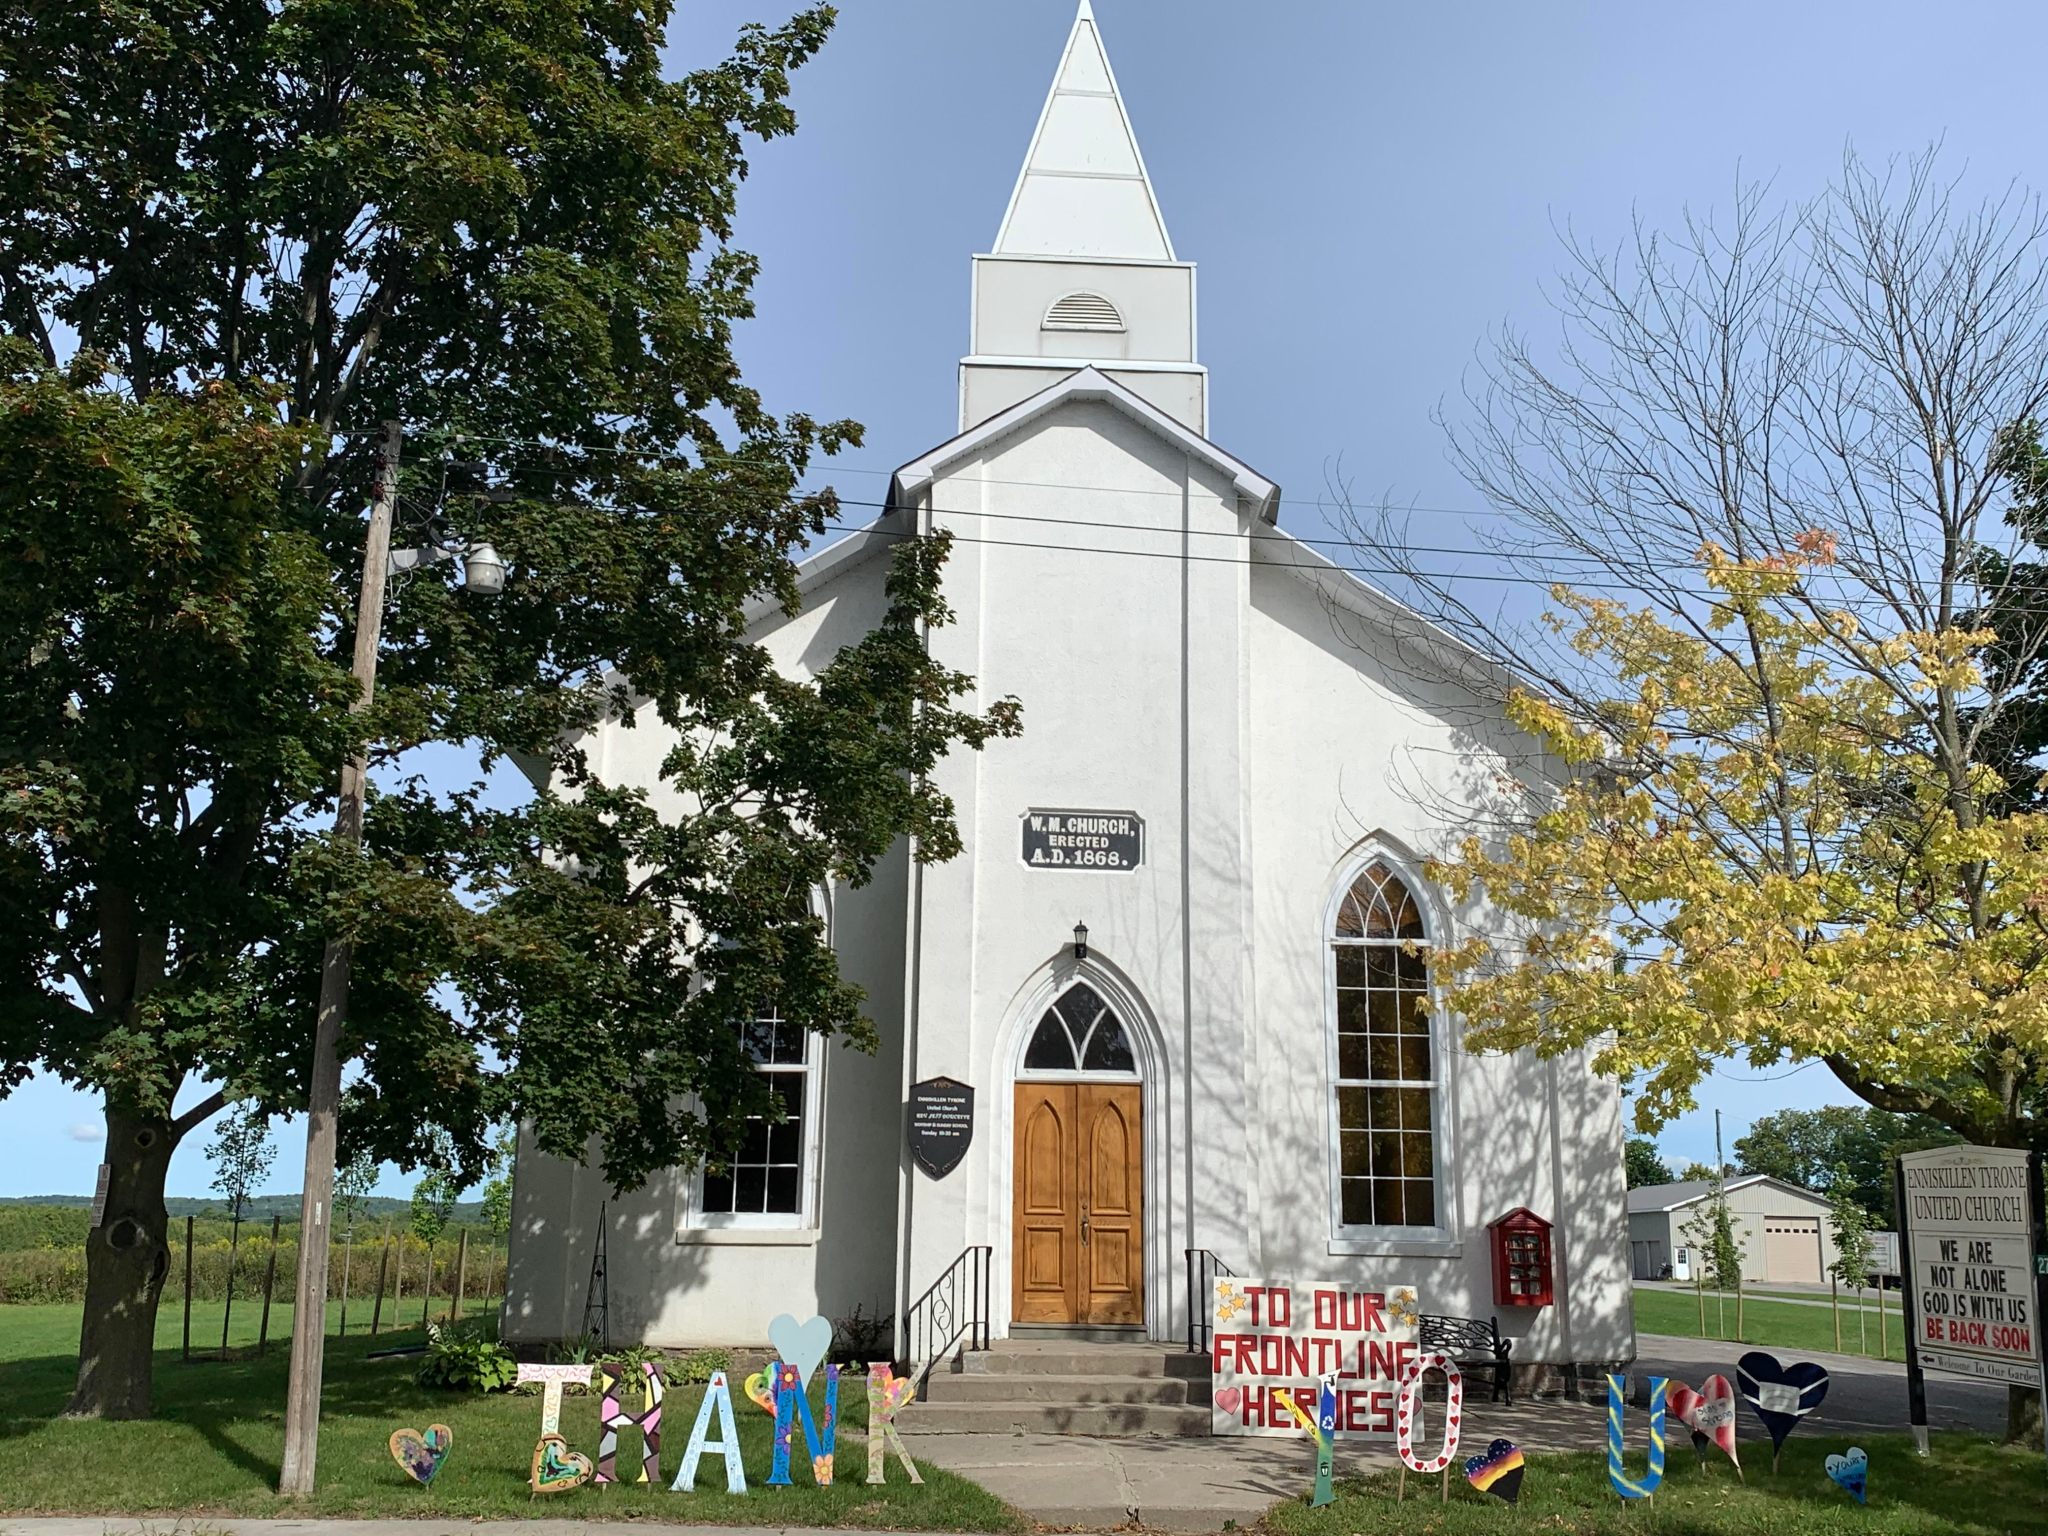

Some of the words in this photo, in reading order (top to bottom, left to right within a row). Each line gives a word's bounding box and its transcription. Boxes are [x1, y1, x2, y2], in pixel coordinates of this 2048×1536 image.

[1067, 817, 1136, 837] CHURCH,
[1048, 834, 1110, 848] ERECTED
[1030, 848, 1071, 865] A.D.
[1073, 849, 1129, 867] 1868.
[1906, 1167, 1977, 1189] ENNISKILLEN
[1978, 1166, 2027, 1189] TYRONE
[1913, 1195, 1962, 1221] UNITED
[1964, 1195, 2023, 1222] CHURCH
[1939, 1240, 1959, 1262] WE
[1968, 1241, 1993, 1264] ARE
[1930, 1265, 1955, 1289] NOT
[1964, 1267, 2007, 1293] ALONE
[1243, 1286, 1290, 1327] TO
[1314, 1290, 1386, 1333] OUR
[1923, 1291, 1950, 1314] GOD
[1953, 1293, 1967, 1317] IS
[1970, 1295, 2004, 1321] WITH
[2008, 1298, 2027, 1324] US
[1926, 1317, 1945, 1340] BE
[1949, 1320, 1988, 1346] BACK
[1992, 1325, 2031, 1352] SOON
[1937, 1355, 1970, 1371] Welcome
[1974, 1361, 1985, 1374] To
[1987, 1363, 2005, 1377] Our
[2008, 1367, 2040, 1383] Garden
[1242, 1385, 1394, 1432] HERES
